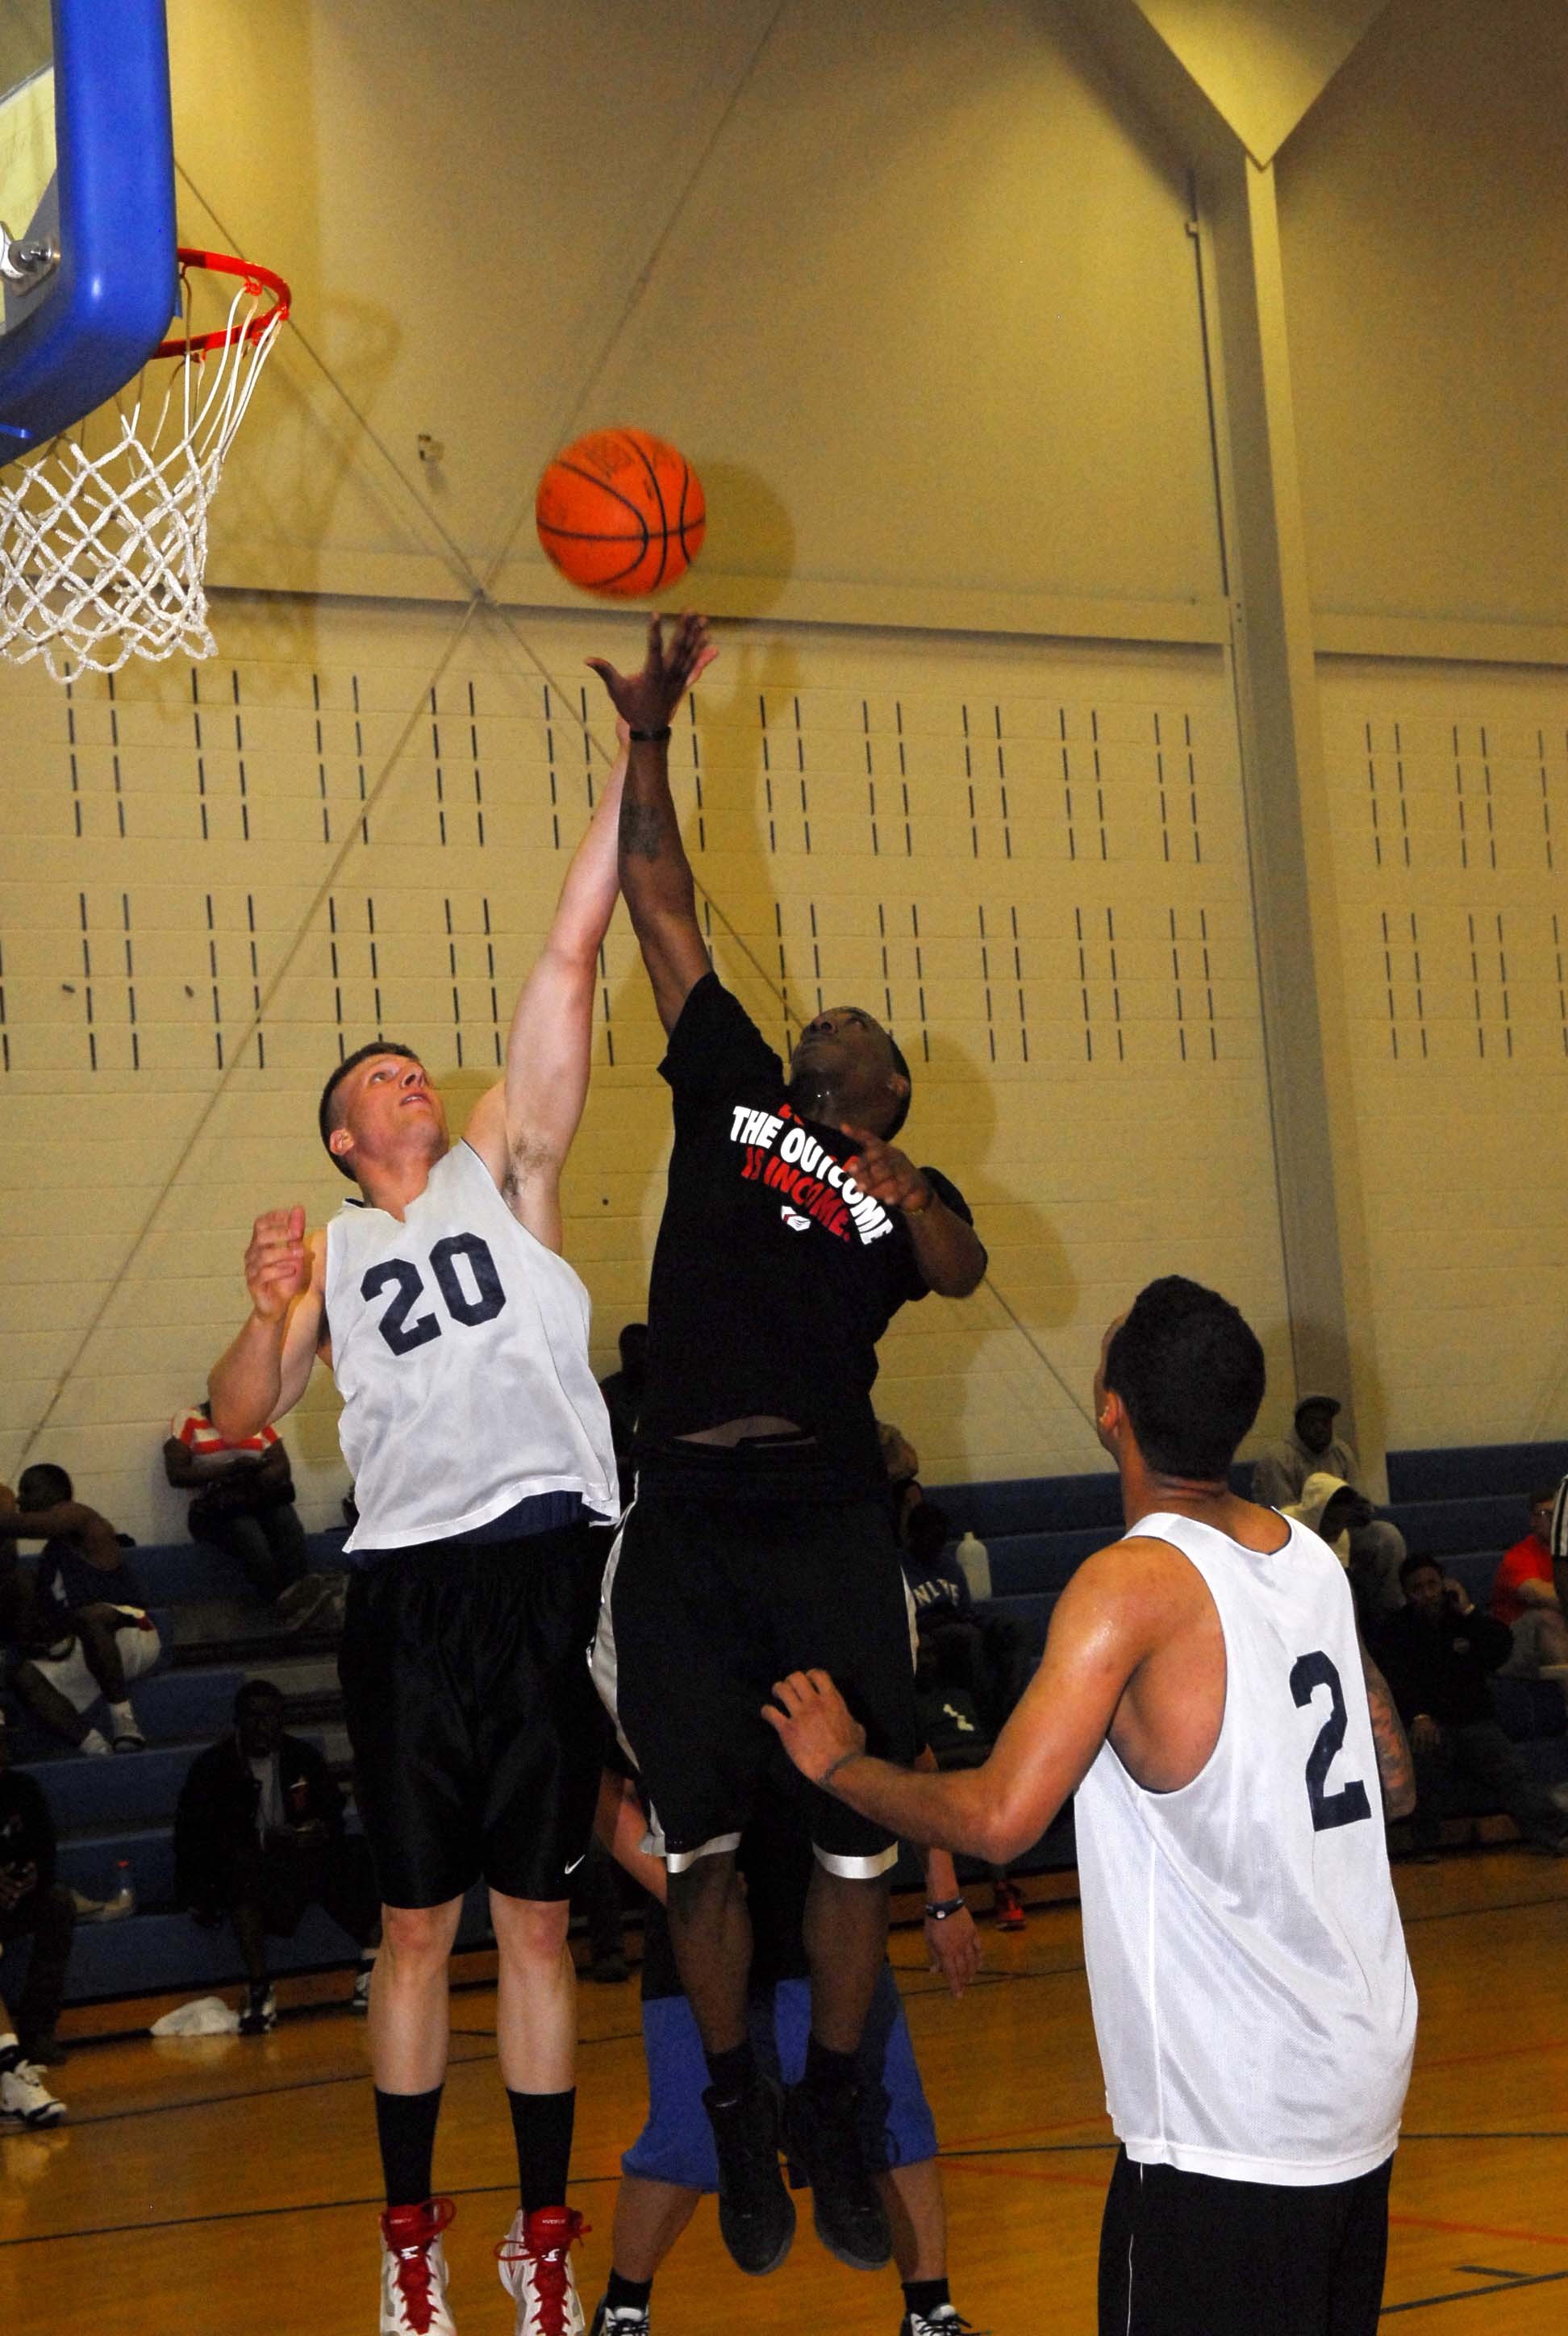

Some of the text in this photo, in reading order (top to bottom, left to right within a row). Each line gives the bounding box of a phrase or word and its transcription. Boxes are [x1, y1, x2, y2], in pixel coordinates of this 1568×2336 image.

[729, 1105, 784, 1149] THE
[740, 1146, 765, 1180] IS
[360, 1232, 507, 1357] 20
[1289, 1650, 1372, 1833] 2
